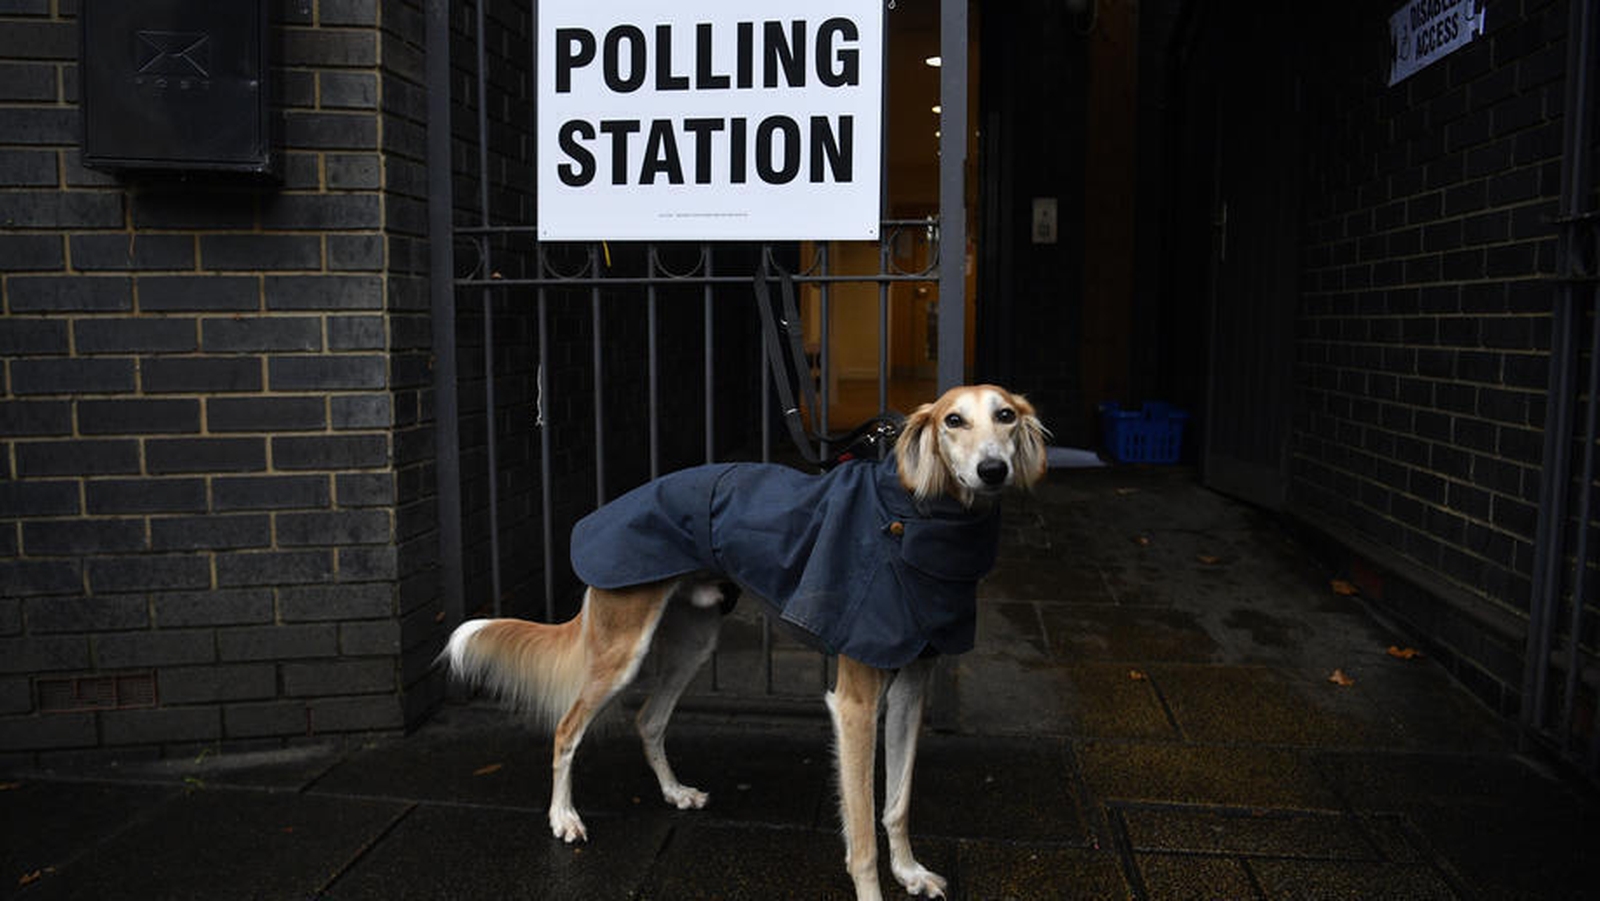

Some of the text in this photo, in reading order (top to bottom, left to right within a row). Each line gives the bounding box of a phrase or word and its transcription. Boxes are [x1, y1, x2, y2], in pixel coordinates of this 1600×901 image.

[1410, 0, 1460, 31] DISAB
[1416, 12, 1458, 60] ACCESS
[555, 17, 860, 93] POLLING
[557, 115, 854, 188] STATION
